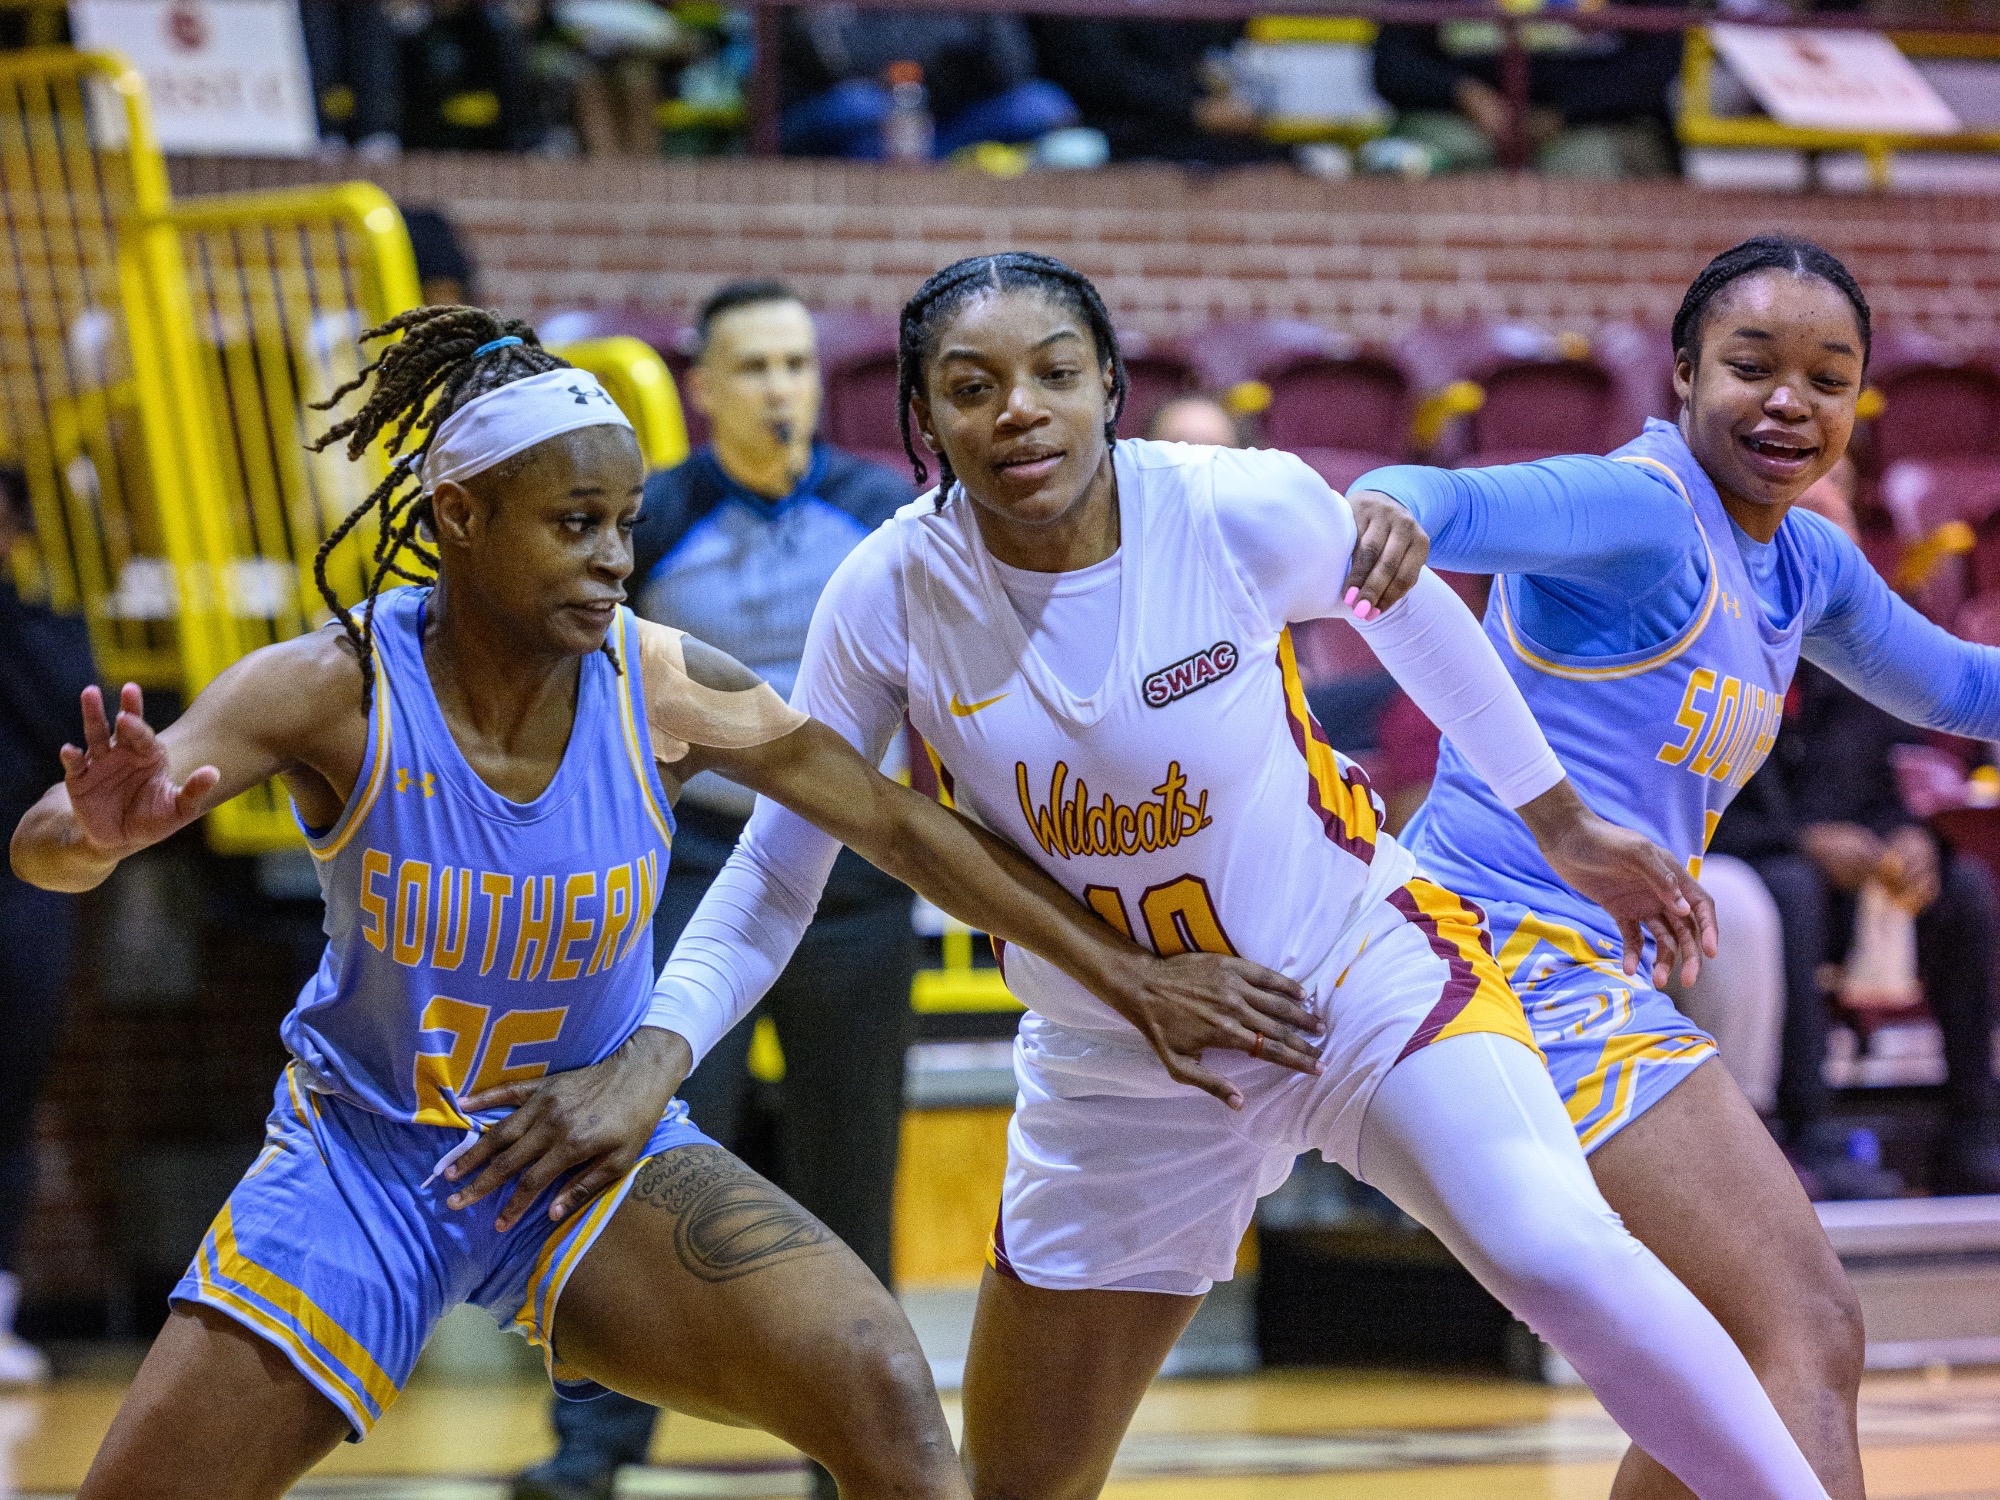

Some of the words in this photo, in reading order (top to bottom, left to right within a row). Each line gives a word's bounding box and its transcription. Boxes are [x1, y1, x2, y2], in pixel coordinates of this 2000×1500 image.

[1143, 640, 1239, 709] SWAC
[1655, 667, 1785, 788] SOUTHE
[1015, 760, 1213, 860] Wildcats
[361, 847, 660, 983] SOUTHERN
